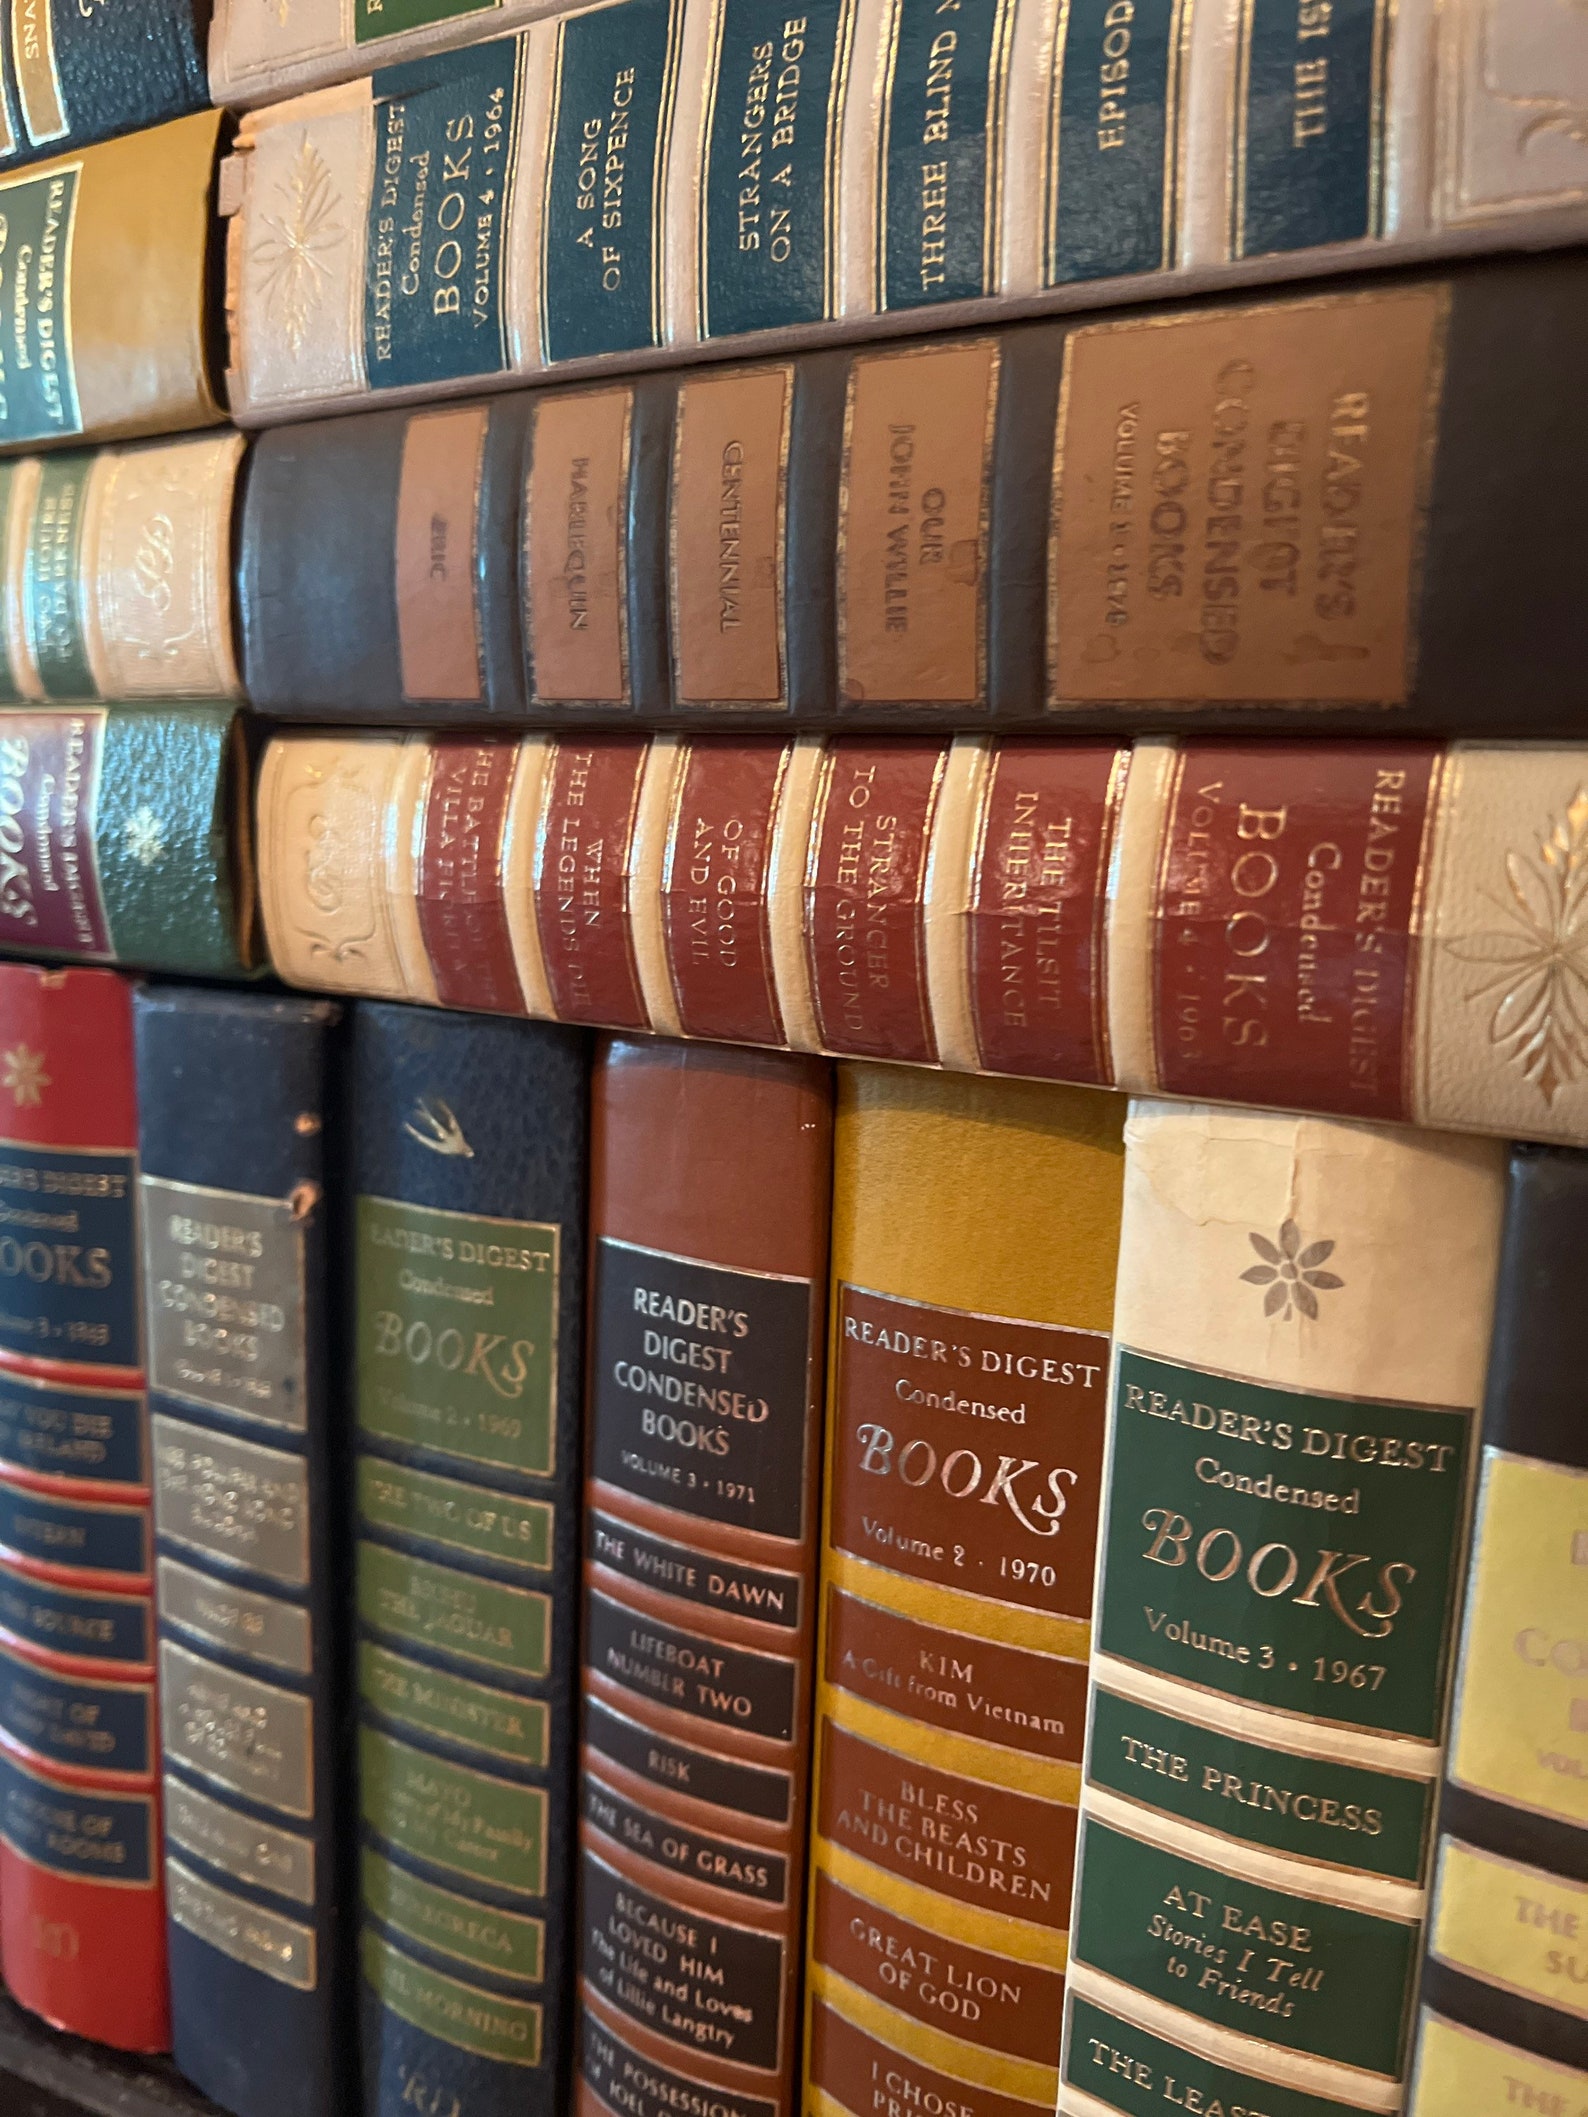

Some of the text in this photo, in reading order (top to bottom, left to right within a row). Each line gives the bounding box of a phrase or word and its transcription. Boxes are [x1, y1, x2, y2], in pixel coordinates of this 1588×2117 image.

[922, 30, 959, 146] BLIND
[576, 117, 602, 249] A SONG
[602, 66, 635, 292] OF SIXPENCE
[738, 39, 774, 251] STRANGERS
[769, 16, 808, 264] ON A BRIDGE
[375, 103, 406, 362] READER'S DIGEST
[402, 150, 430, 295] Condensed
[433, 114, 474, 316] BOOKS
[473, 86, 505, 328] VOLUME 4 1964
[921, 160, 950, 292] THREE
[36, 318, 64, 425] DIGEST
[1109, 401, 1141, 512] VOLUME
[563, 456, 591, 631] HARLEQUIN
[719, 439, 745, 635] CENTENNIAL
[883, 423, 916, 634] JOHN WILLIE
[919, 486, 948, 566] OUR
[1148, 429, 1193, 600] BOOKS
[1202, 358, 1254, 666] CONDENSED
[1314, 391, 1371, 621] READER'S
[439, 766, 465, 848] VILLA
[567, 752, 592, 808] THE
[558, 818, 581, 953] LEGENDS
[583, 838, 604, 930] WHEN
[689, 817, 714, 966] AND EVIL
[716, 818, 744, 968] OF GOOD
[1178, 780, 1223, 917] VOLUME
[834, 765, 876, 1032] TO THE GROUND
[866, 814, 897, 990] STRANGER
[1000, 790, 1039, 1029] INHERITANCE
[1036, 817, 1072, 1010] THE TILSIT
[1222, 801, 1288, 1048] BOOKS
[1296, 841, 1342, 1024] Condensed
[1348, 768, 1406, 1096] READER'S DIGEST
[399, 1267, 497, 1308] Condensed
[458, 1239, 551, 1274] DIGEST
[374, 1309, 537, 1400] BOOKS
[632, 1285, 750, 1338] READER'S
[643, 1329, 733, 1375] DIGEST
[843, 1315, 1102, 1389] READER'S DIGEST
[613, 1360, 771, 1424] CONDENSED
[641, 1408, 731, 1457] BOOKS
[894, 1377, 1028, 1426] Condensed
[1123, 1383, 1456, 1474] READER'S DIGEST
[620, 1450, 756, 1504] VOLUME 3 1971
[855, 1422, 1080, 1537] BOOKS
[1193, 1455, 1362, 1515] Condensed
[501, 1515, 534, 1543] US
[593, 1529, 786, 1612] THE WHITE DAWN
[860, 1514, 1059, 1588] Volume 2 1970
[1140, 1506, 1419, 1640] BOOKS
[629, 1629, 726, 1680] LIFEBOAT
[842, 1648, 859, 1671] A
[906, 1674, 959, 1710] from
[966, 1691, 1066, 1736] Vietnam
[918, 1649, 976, 1685] KIM
[1141, 1605, 1390, 1693] Volume 3 1967
[695, 1683, 754, 1718] TWO
[647, 1748, 692, 1784] RISK
[900, 1778, 980, 1826] BLESS
[1120, 1734, 1385, 1837] THE PRINCESS
[622, 1816, 655, 1850] SEA
[660, 1836, 690, 1862] OF
[696, 1850, 770, 1889] GRASS
[835, 1808, 1052, 1903] AND CHILDREN
[859, 1788, 1028, 1869] THE BEASTS
[607, 1913, 726, 1987] LOVED HIM
[613, 1890, 719, 1956] BECAUSE I
[849, 1916, 1022, 2006] GREAT LION
[1146, 1912, 1326, 1994] Stories I Tell
[1162, 1884, 1314, 1955] AT EASE
[1513, 1894, 1580, 1940] THE
[615, 1976, 658, 2017] Lillie
[660, 2003, 737, 2050] Langtry
[652, 1974, 689, 2003] and
[693, 1989, 755, 2024] Loves
[878, 1960, 983, 2023] OF GOD
[1166, 1954, 1298, 2020] to Friends
[871, 2060, 878, 2081] I
[885, 2071, 975, 2117] CHOSE
[1087, 2037, 1272, 2117] THE LEA
